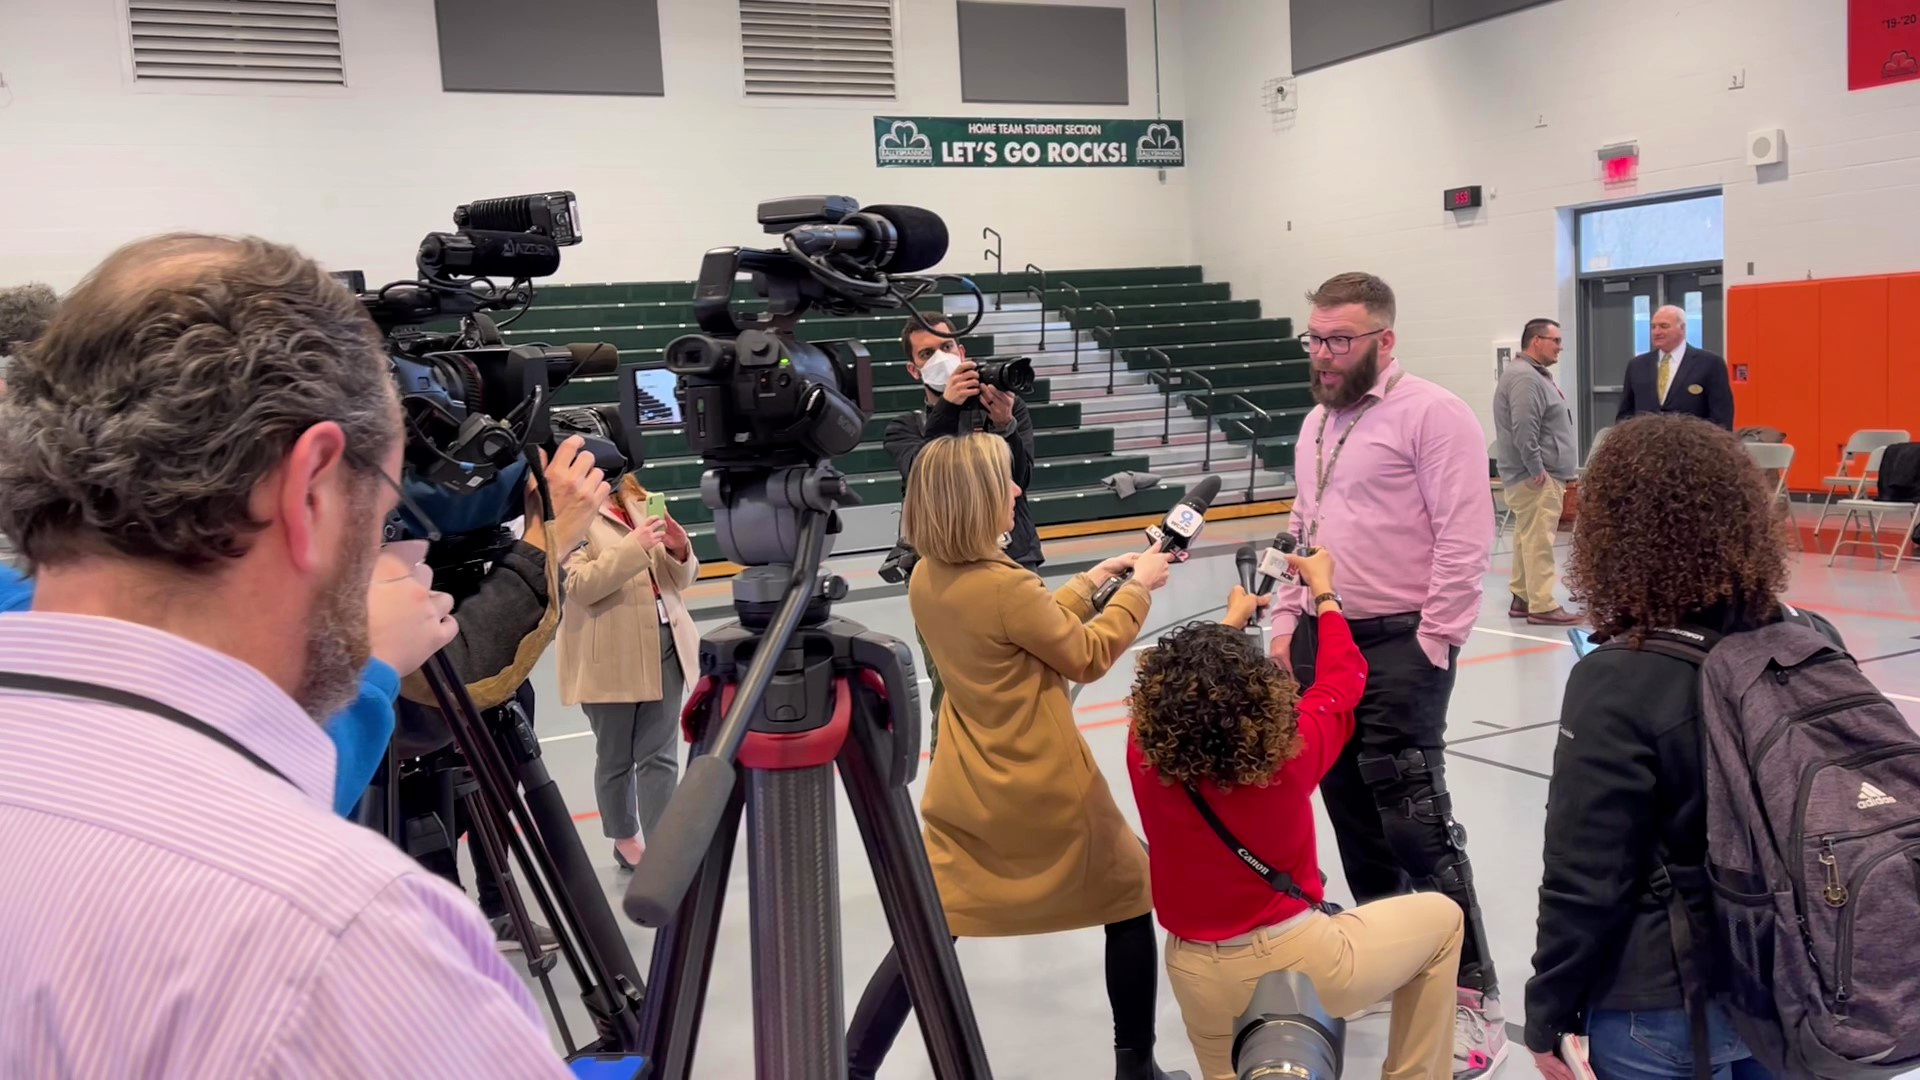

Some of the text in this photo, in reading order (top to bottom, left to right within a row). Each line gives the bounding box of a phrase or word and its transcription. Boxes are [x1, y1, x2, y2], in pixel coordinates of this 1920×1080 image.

[968, 123, 1101, 135] HOME TEAM STUDENT SECTION
[942, 141, 1127, 164] LET'S GO ROCKS!
[1171, 520, 1189, 534] WCPO
[1857, 796, 1897, 809] adidas
[1237, 848, 1270, 875] Canon
